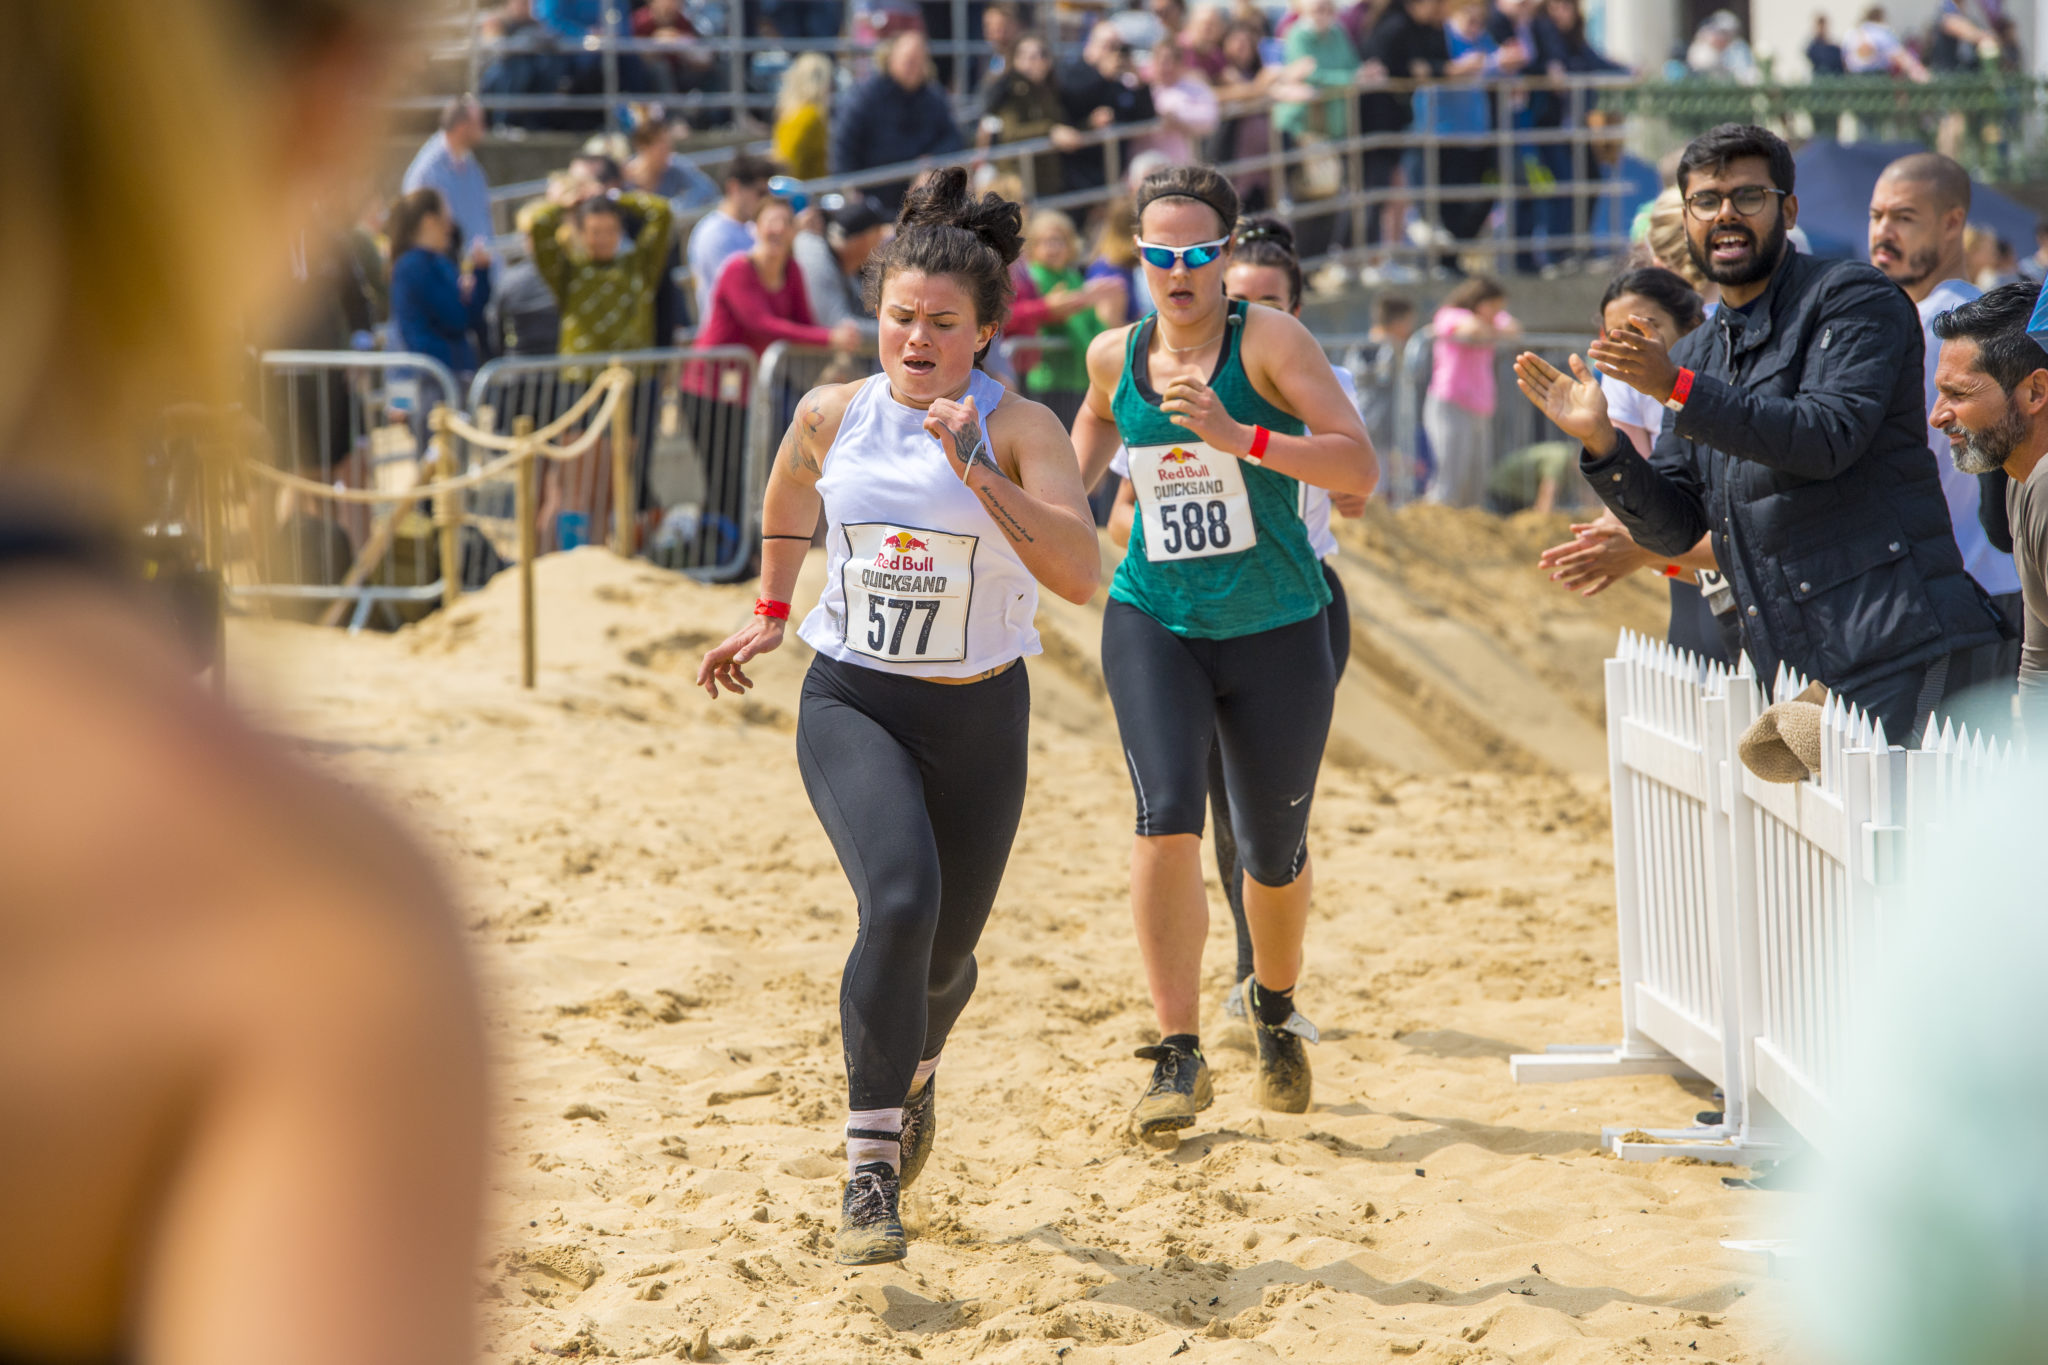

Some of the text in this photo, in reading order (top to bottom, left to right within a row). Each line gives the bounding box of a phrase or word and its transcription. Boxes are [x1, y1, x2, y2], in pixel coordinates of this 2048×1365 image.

[1158, 464, 1210, 481] Red Bull
[1154, 480, 1224, 500] QUICKSAND
[1160, 500, 1231, 554] 588
[874, 552, 933, 572] Red Bull
[862, 569, 947, 593] QUICKSAND
[867, 593, 941, 655] 577
